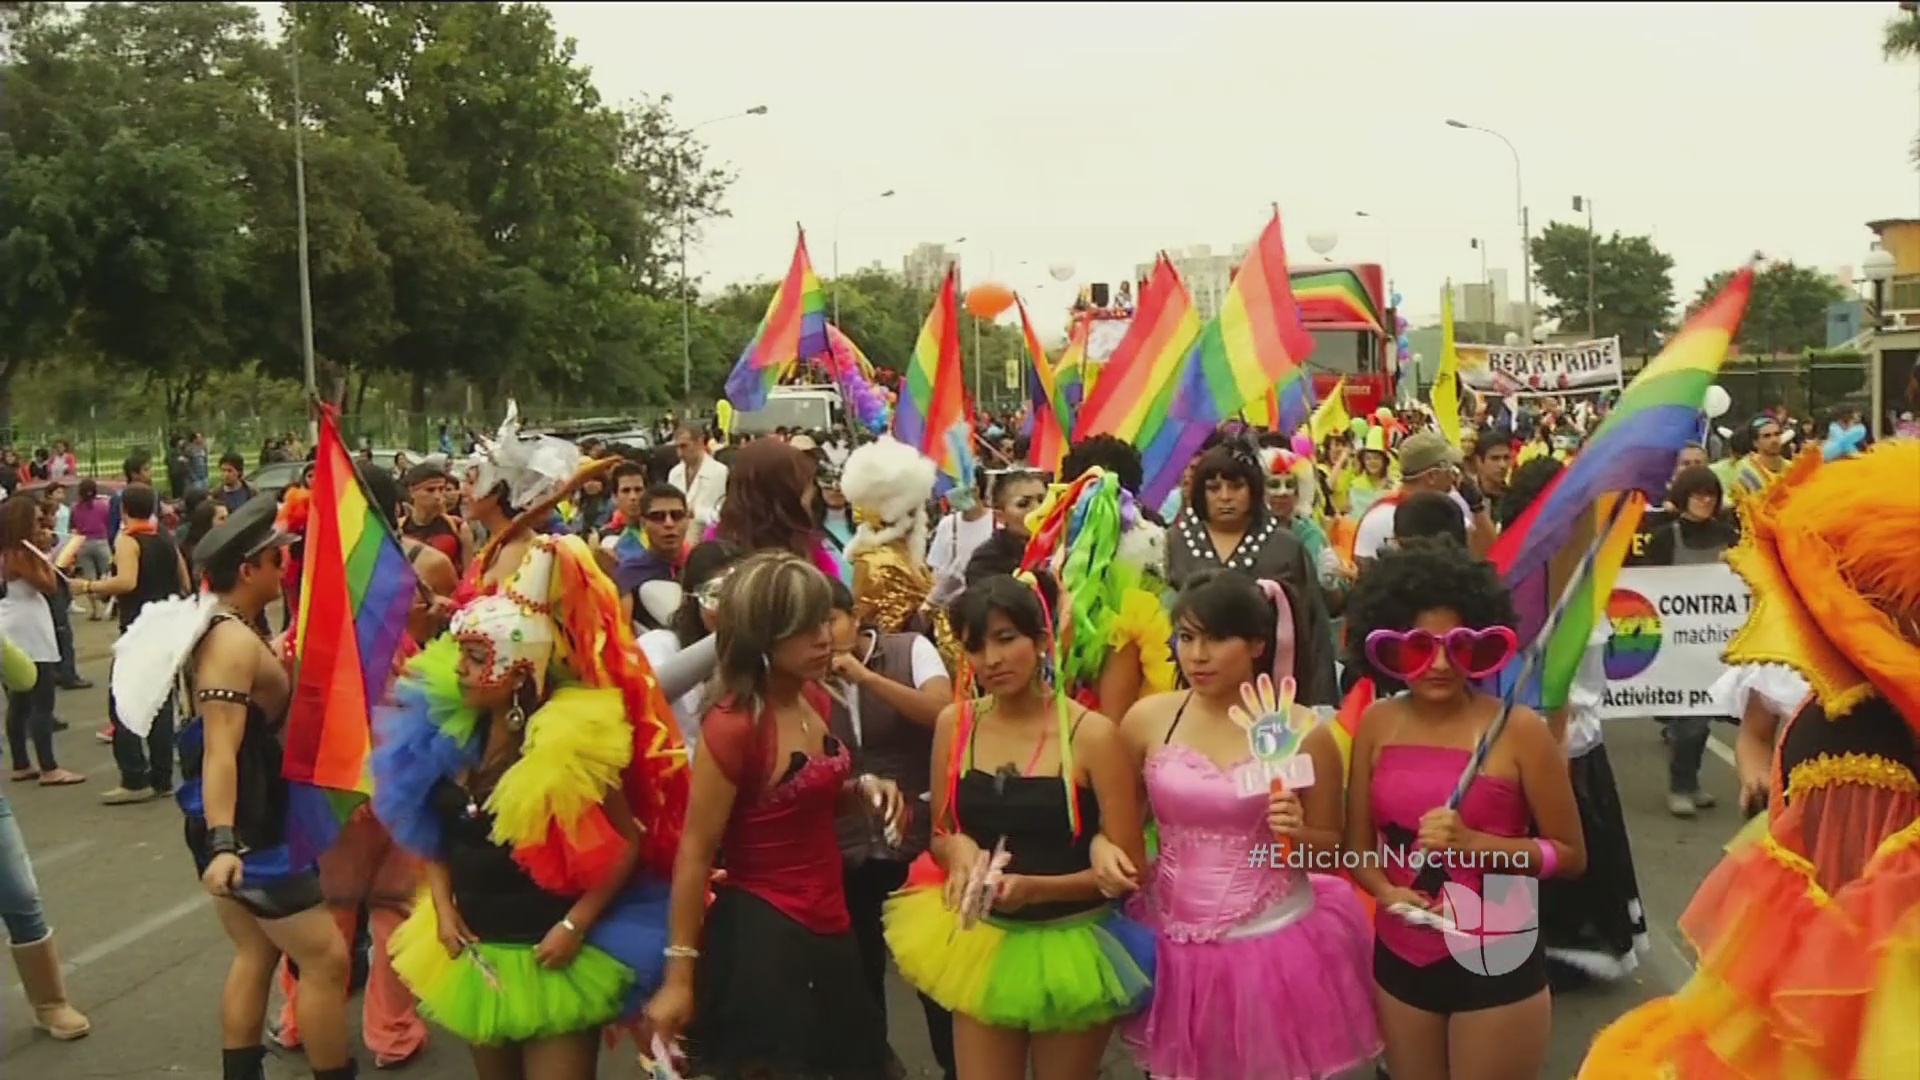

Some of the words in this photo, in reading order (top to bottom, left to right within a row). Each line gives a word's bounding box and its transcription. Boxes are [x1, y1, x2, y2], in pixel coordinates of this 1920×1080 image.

[1489, 350, 1546, 376] BEAR
[1551, 343, 1613, 373] PRIDE
[1660, 595, 1737, 615] CONTRA
[1603, 686, 1682, 706] Activistas
